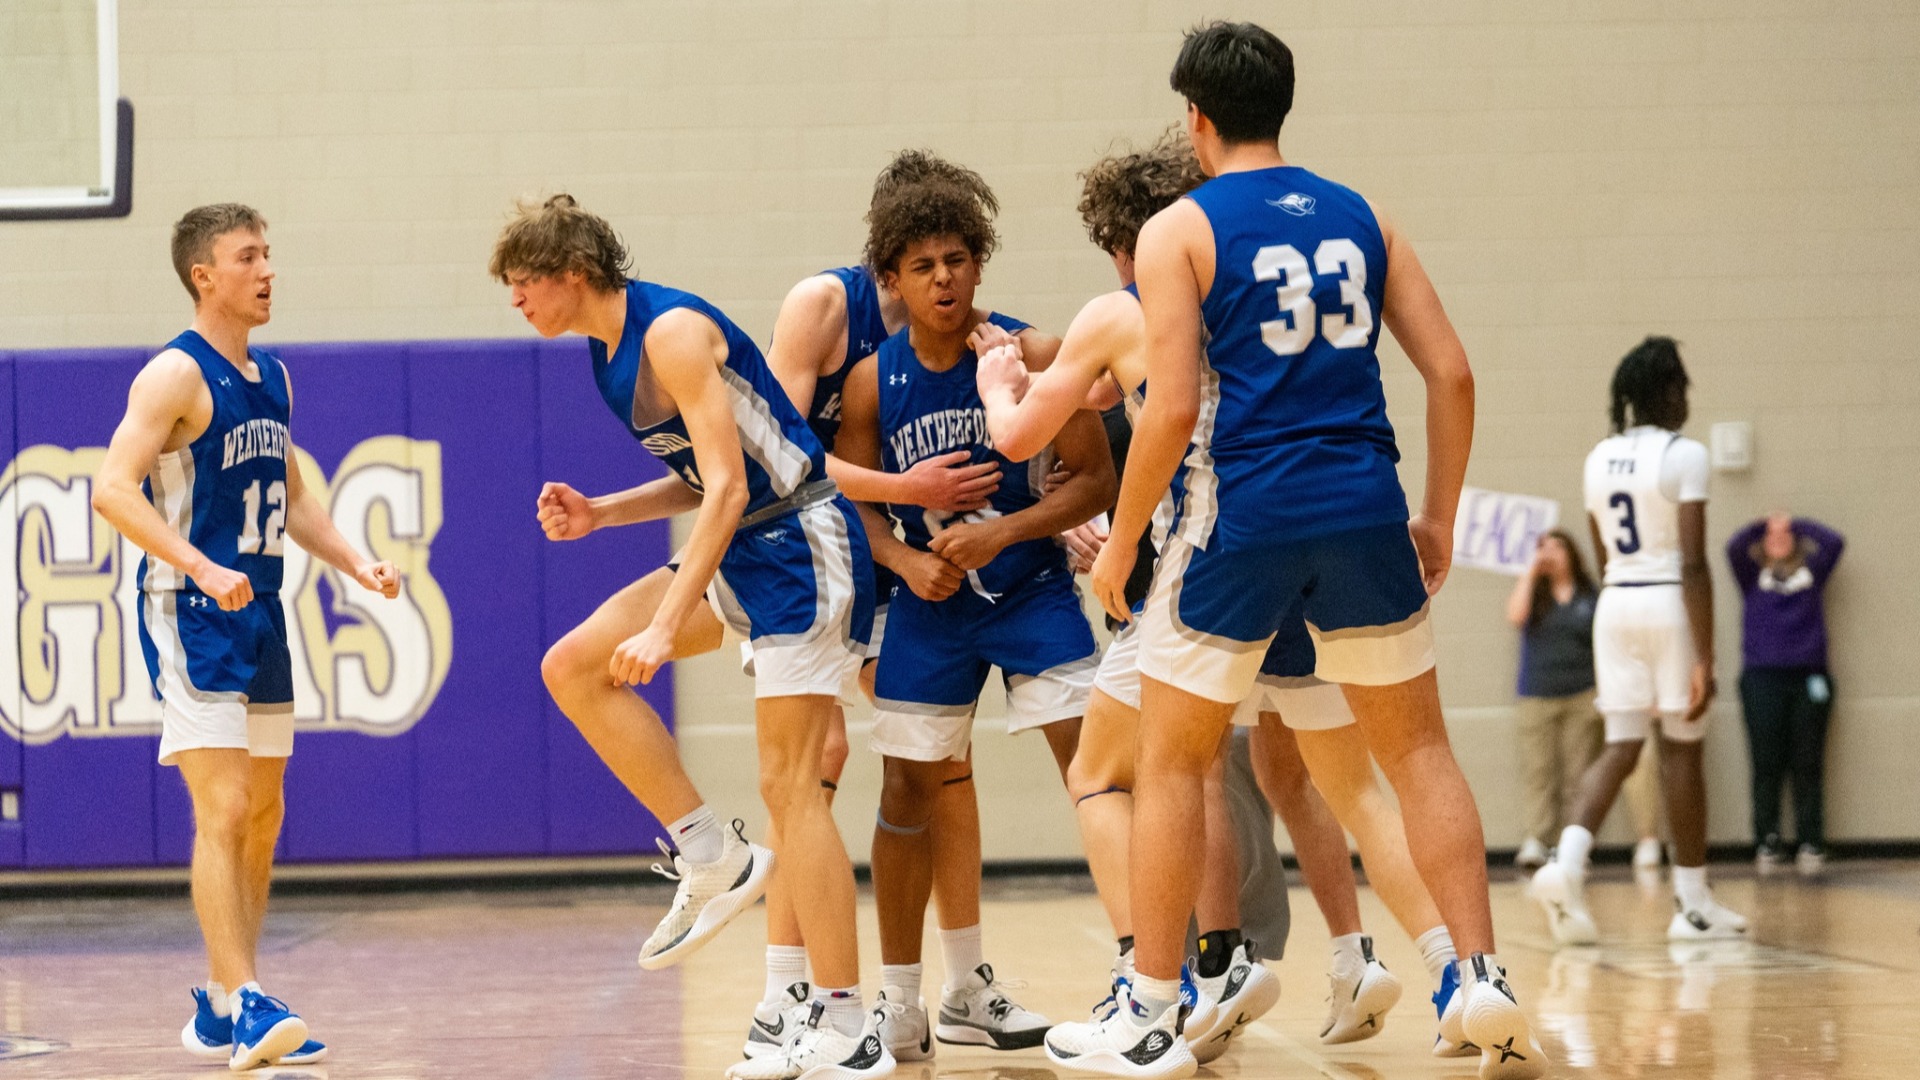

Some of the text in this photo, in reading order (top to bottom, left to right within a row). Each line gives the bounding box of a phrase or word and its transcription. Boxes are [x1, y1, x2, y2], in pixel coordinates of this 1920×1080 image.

[1252, 238, 1373, 356] 33
[237, 479, 286, 557] 12
[1609, 492, 1641, 555] 3
